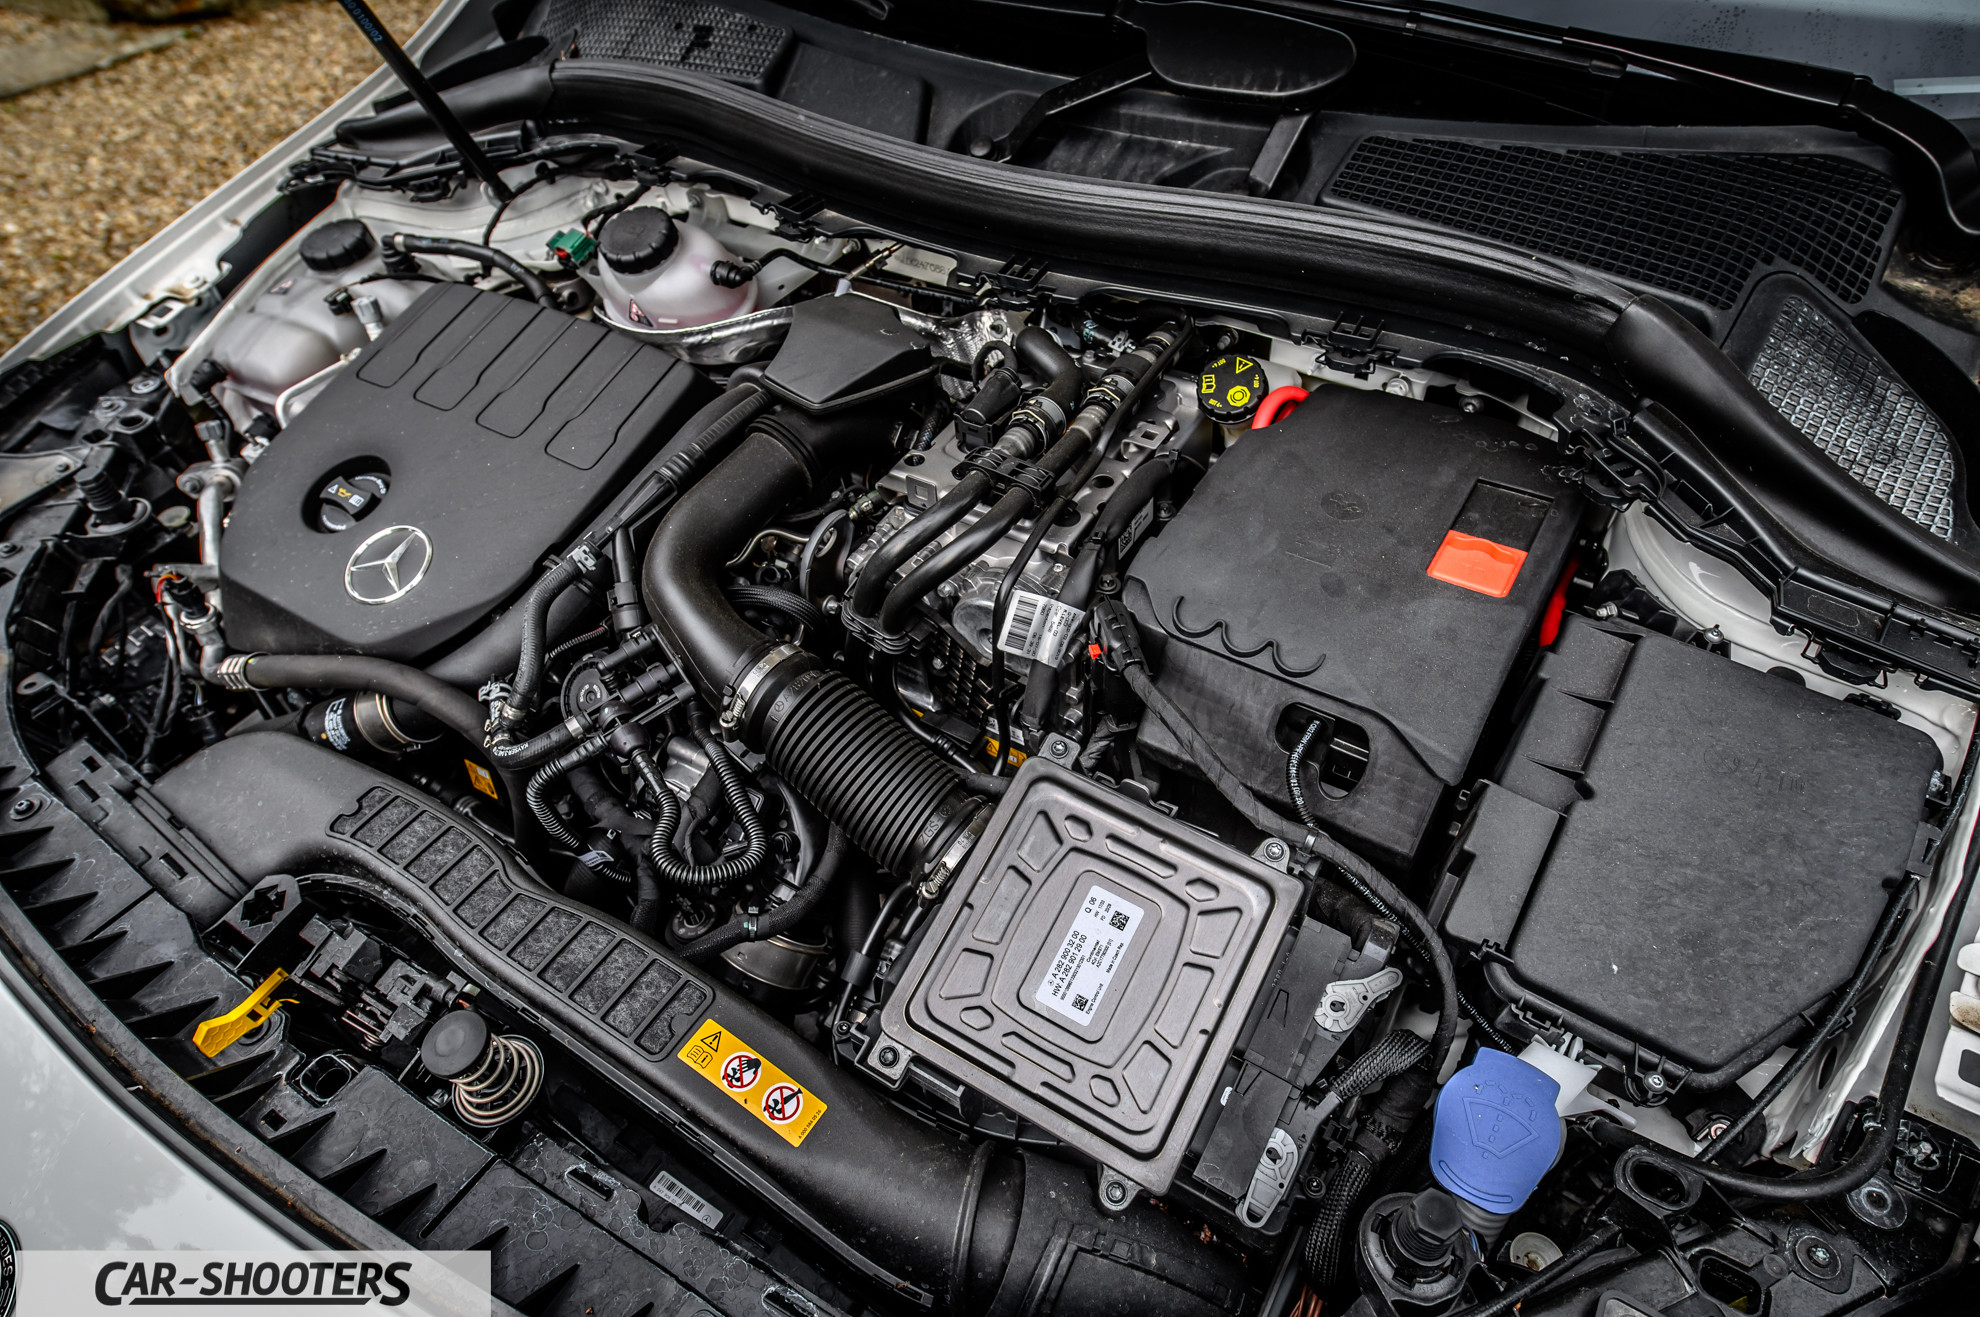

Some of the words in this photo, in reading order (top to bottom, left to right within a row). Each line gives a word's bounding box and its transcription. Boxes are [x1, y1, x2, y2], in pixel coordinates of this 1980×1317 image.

[1088, 896, 1097, 905] 06
[1054, 959, 1065, 972] 282
[1060, 947, 1071, 960] 900
[1067, 938, 1075, 948] 32
[1071, 930, 1080, 939] 00
[1061, 963, 1072, 976] 282
[1068, 951, 1078, 964] 901
[1074, 942, 1082, 952] 29
[1078, 933, 1087, 943] 00
